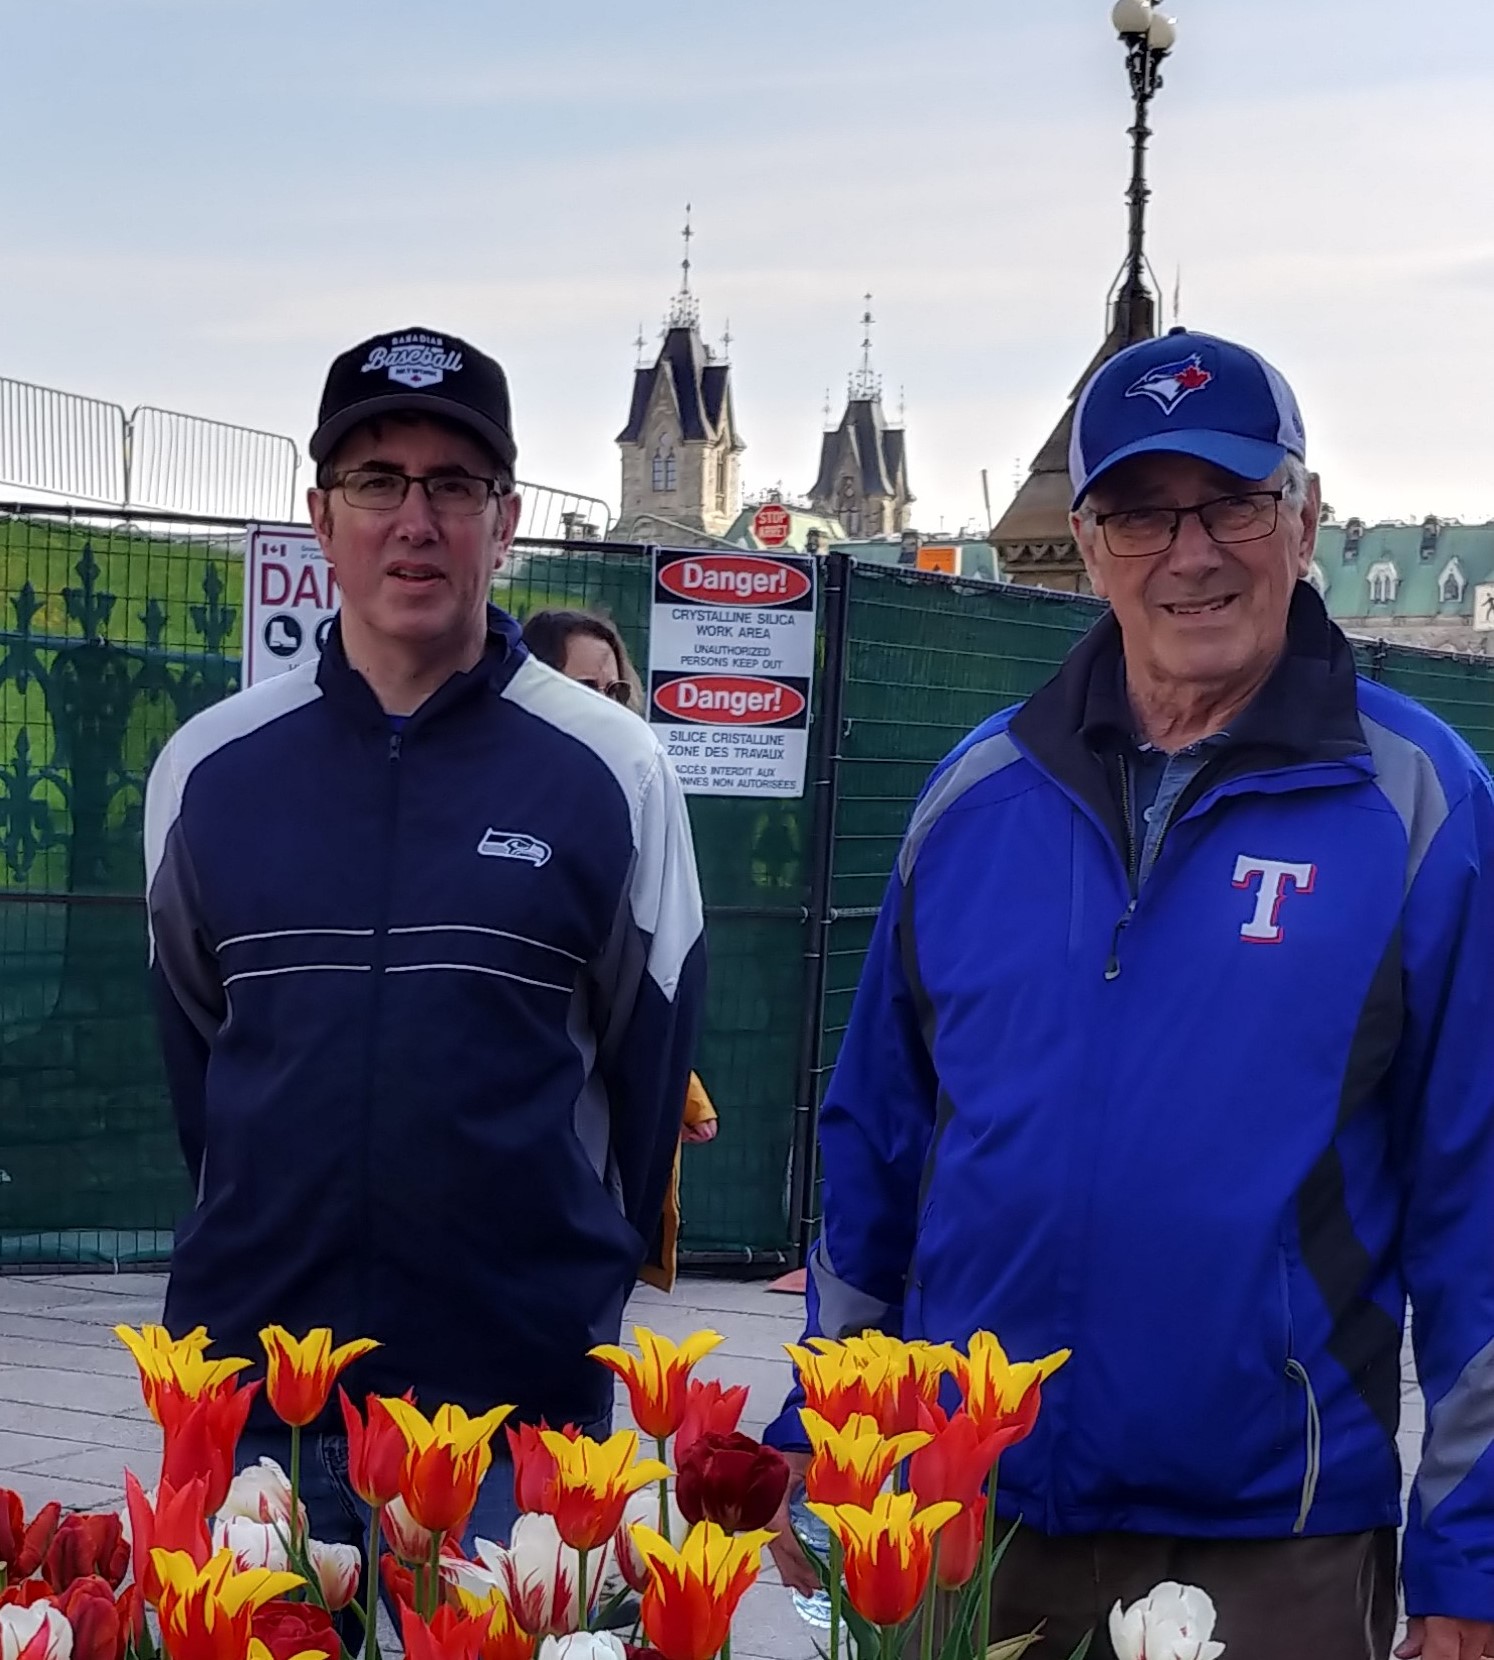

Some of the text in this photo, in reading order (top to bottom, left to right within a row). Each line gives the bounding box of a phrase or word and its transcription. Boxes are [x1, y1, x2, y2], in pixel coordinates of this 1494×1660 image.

[360, 346, 463, 373] Baseball
[682, 562, 788, 598] Danger!
[671, 608, 796, 626] CRYSTALLINE SILICA
[696, 625, 771, 639] WORK AREA
[694, 644, 772, 657] UNAUTHORIZED
[680, 655, 784, 669] PERSONS KEEP OUT
[677, 682, 783, 717] Danger!
[669, 730, 785, 746] SILICE CRISTALLINE
[667, 744, 785, 760] ZONE DES TRAVAUX
[710, 766, 754, 776] INTERDIT
[757, 767, 776, 777] AUX
[712, 777, 734, 787] NON
[1231, 854, 1318, 944] T
